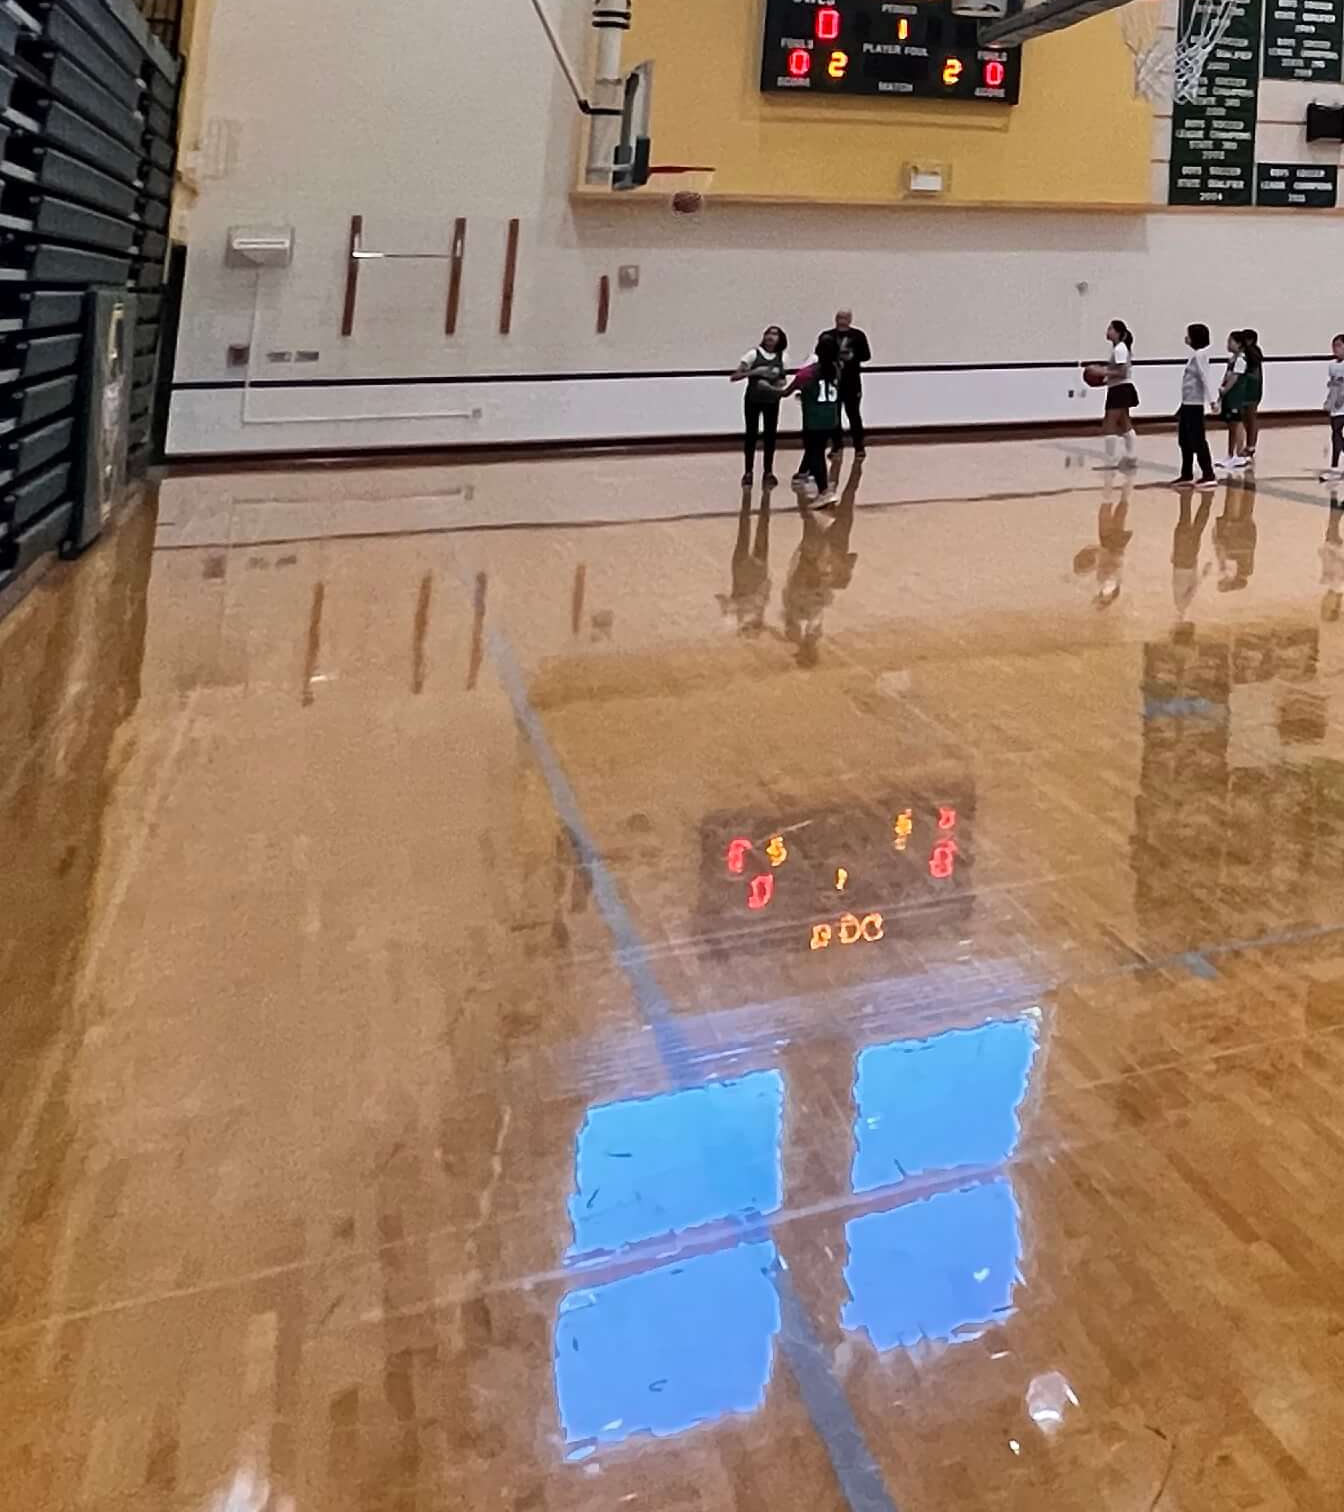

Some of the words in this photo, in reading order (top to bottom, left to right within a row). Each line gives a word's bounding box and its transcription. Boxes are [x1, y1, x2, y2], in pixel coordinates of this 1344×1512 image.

[817, 9, 840, 39] 0
[898, 18, 908, 40] 1
[789, 50, 810, 76] 0
[828, 51, 849, 78] 2
[942, 58, 963, 86] 2
[985, 61, 1005, 86] 0
[817, 379, 838, 403] 15
